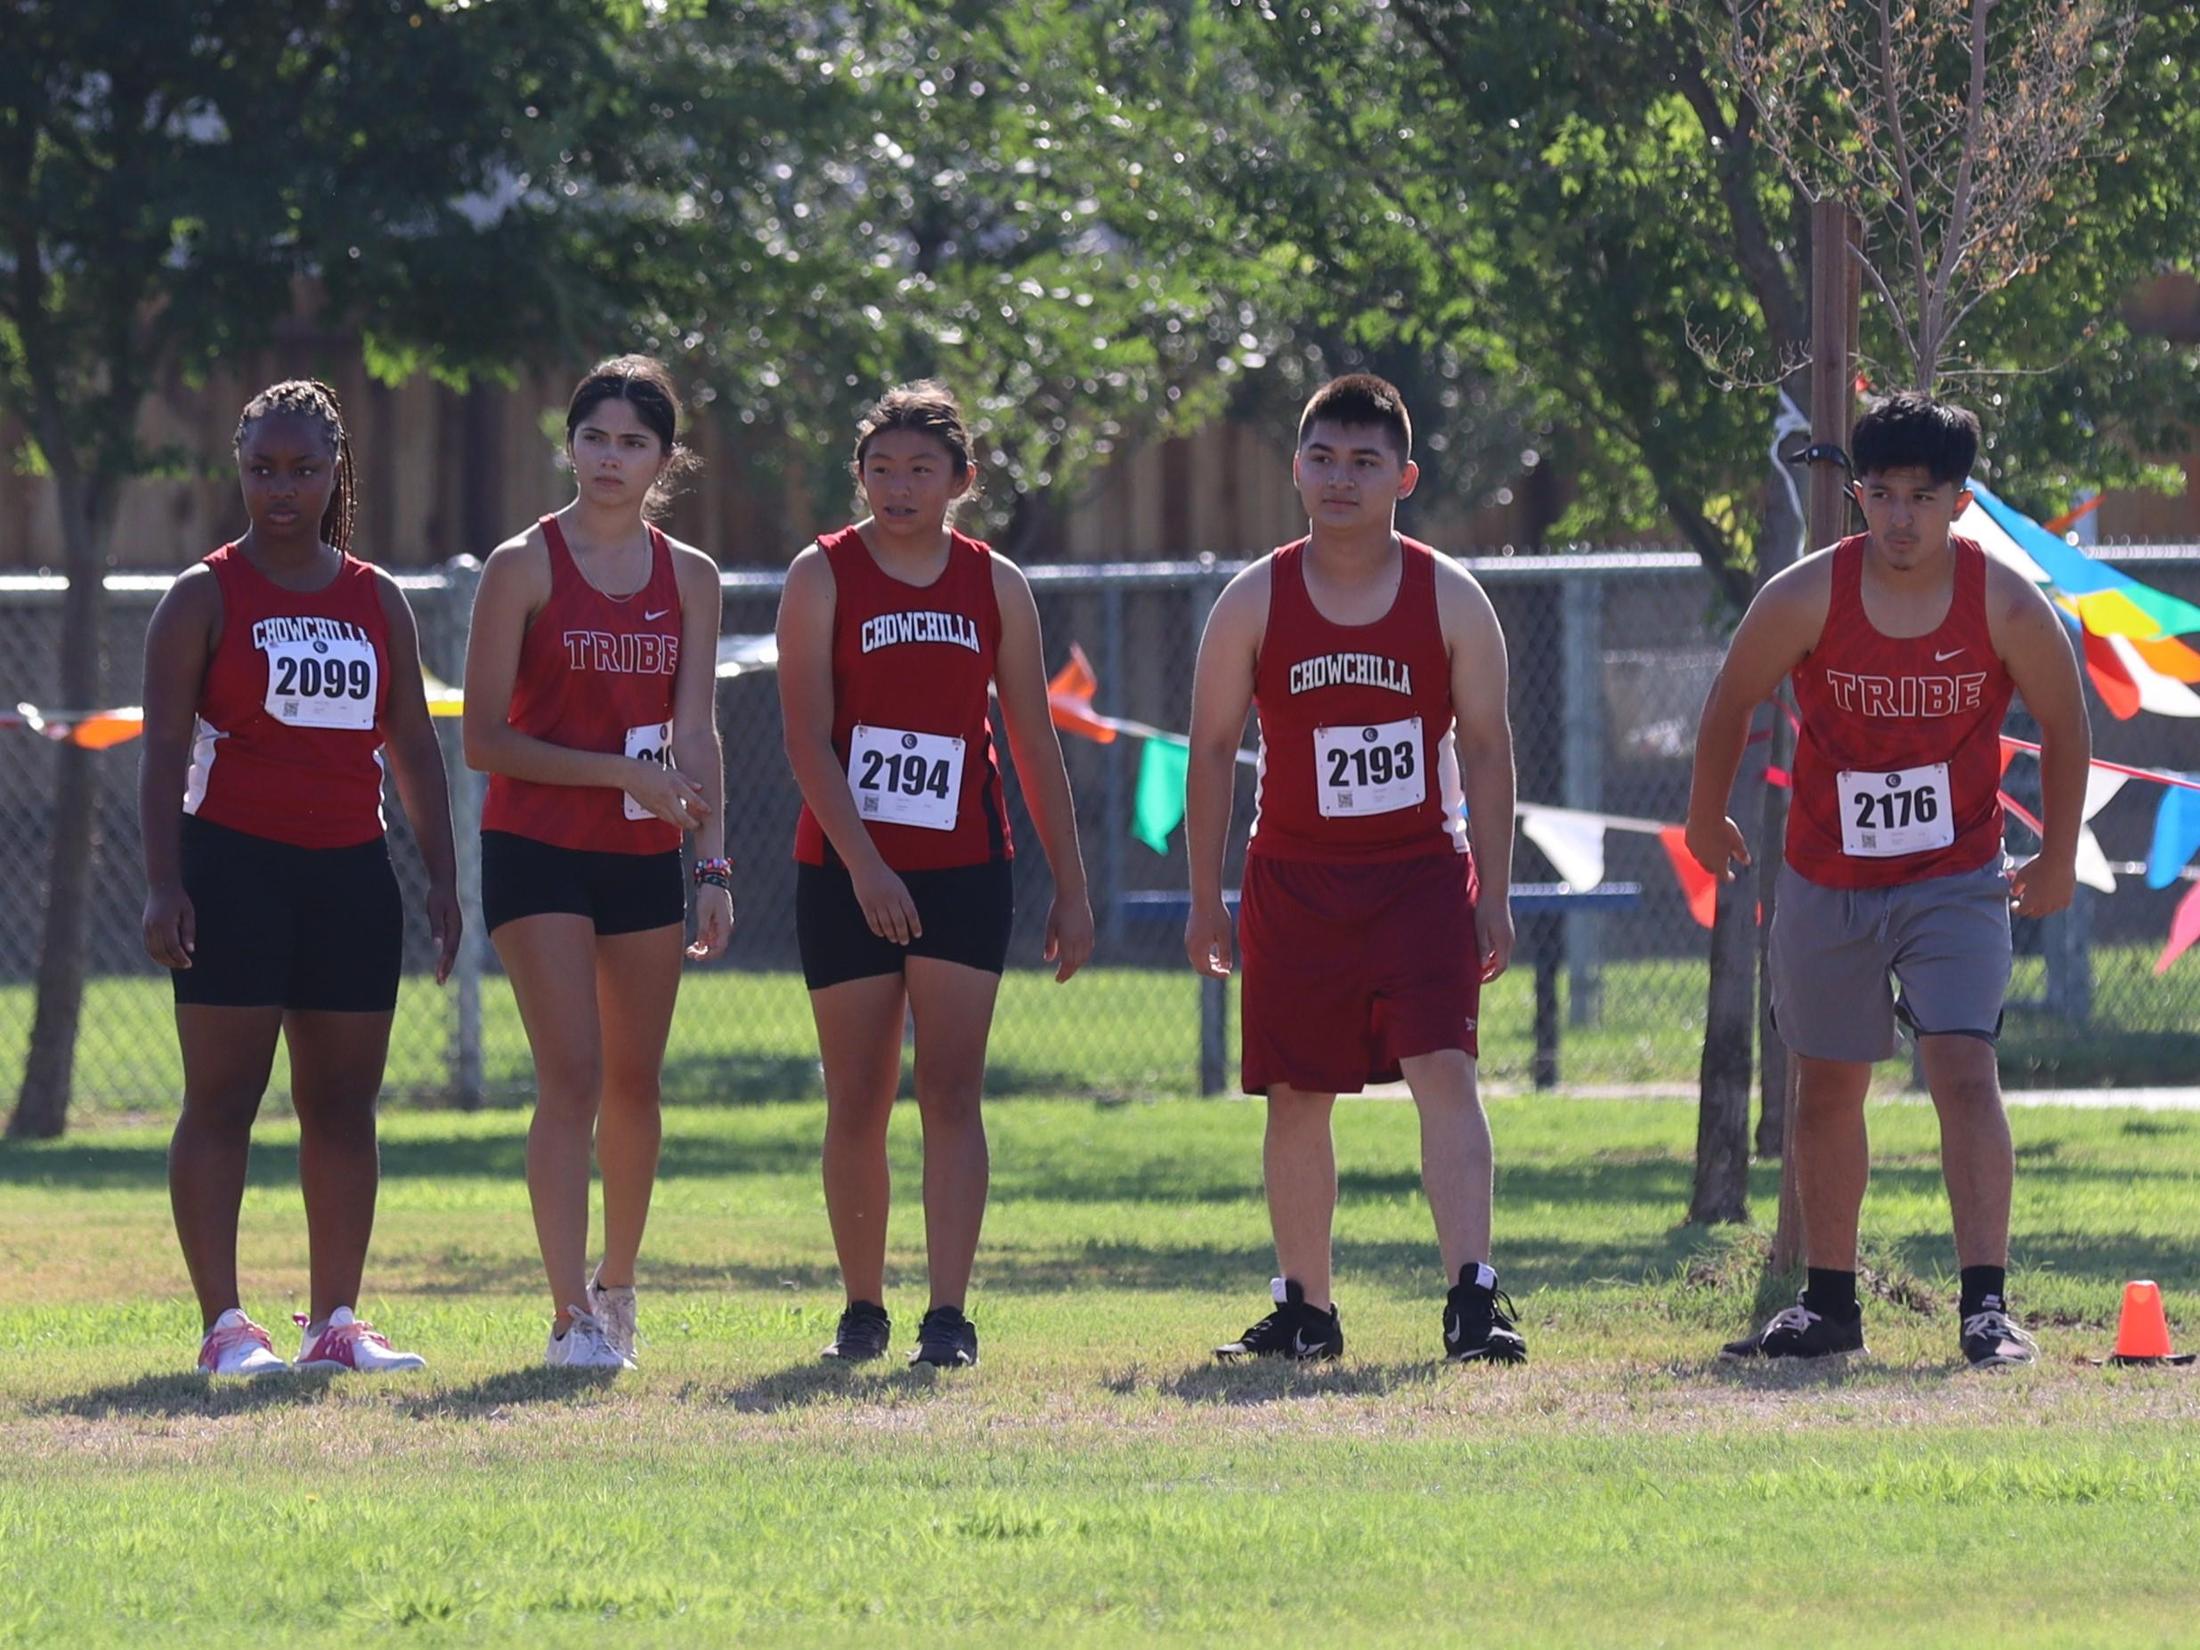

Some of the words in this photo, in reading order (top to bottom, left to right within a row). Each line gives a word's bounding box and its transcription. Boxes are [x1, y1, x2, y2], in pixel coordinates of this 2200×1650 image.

[563, 631, 679, 675] TRIBE
[861, 611, 980, 654] CHOWCHILLA
[275, 657, 371, 700] 2099
[1290, 653, 1412, 696] CHOWCHILLA
[1827, 669, 1987, 717] TRIBE
[859, 750, 950, 799] 2194
[1327, 741, 1415, 787] 2193
[1854, 786, 1938, 829] 2176
